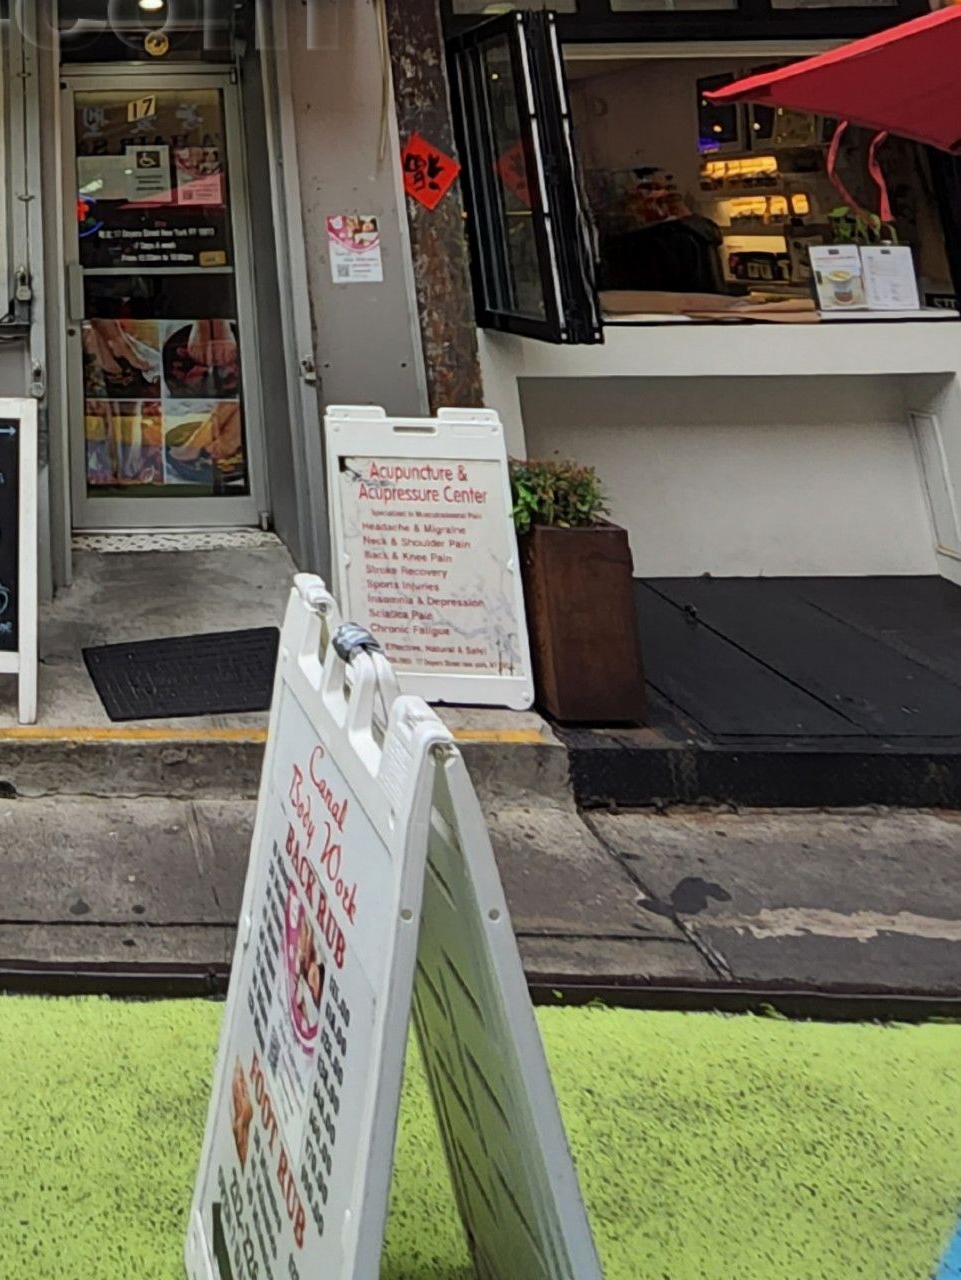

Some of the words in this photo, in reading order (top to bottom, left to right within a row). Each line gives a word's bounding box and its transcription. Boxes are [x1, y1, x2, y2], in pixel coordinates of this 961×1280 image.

[133, 98, 153, 118] 17
[369, 462, 454, 483] Acupuncture
[457, 465, 468, 482] &
[358, 483, 440, 505] Acupressure
[443, 486, 487, 504] Center
[362, 522, 410, 532] Headache
[413, 523, 420, 533] &
[424, 524, 467, 535] Migraine
[362, 535, 387, 546] Neck
[391, 537, 398, 546] &
[401, 537, 445, 547] Shoulder
[449, 539, 471, 549] Pain
[364, 550, 388, 560] Back
[392, 551, 399, 561] &
[402, 552, 428, 562] Knee
[431, 553, 453, 564] Pain
[365, 565, 397, 575] Stroke
[401, 566, 448, 579] Recovery
[367, 579, 399, 590] Sports
[402, 581, 440, 592] Injuries
[367, 594, 414, 605] Insomnia
[418, 596, 425, 605] &
[427, 596, 485, 609] Depression
[369, 622, 409, 633] Chronic
[413, 624, 450, 637] Fatigue
[309, 745, 349, 833] Canal
[289, 763, 316, 850] Body
[286, 821, 317, 910] BACK
[317, 889, 346, 970] RUB
[250, 1047, 279, 1157] FOOT
[277, 1141, 306, 1249] RUB
